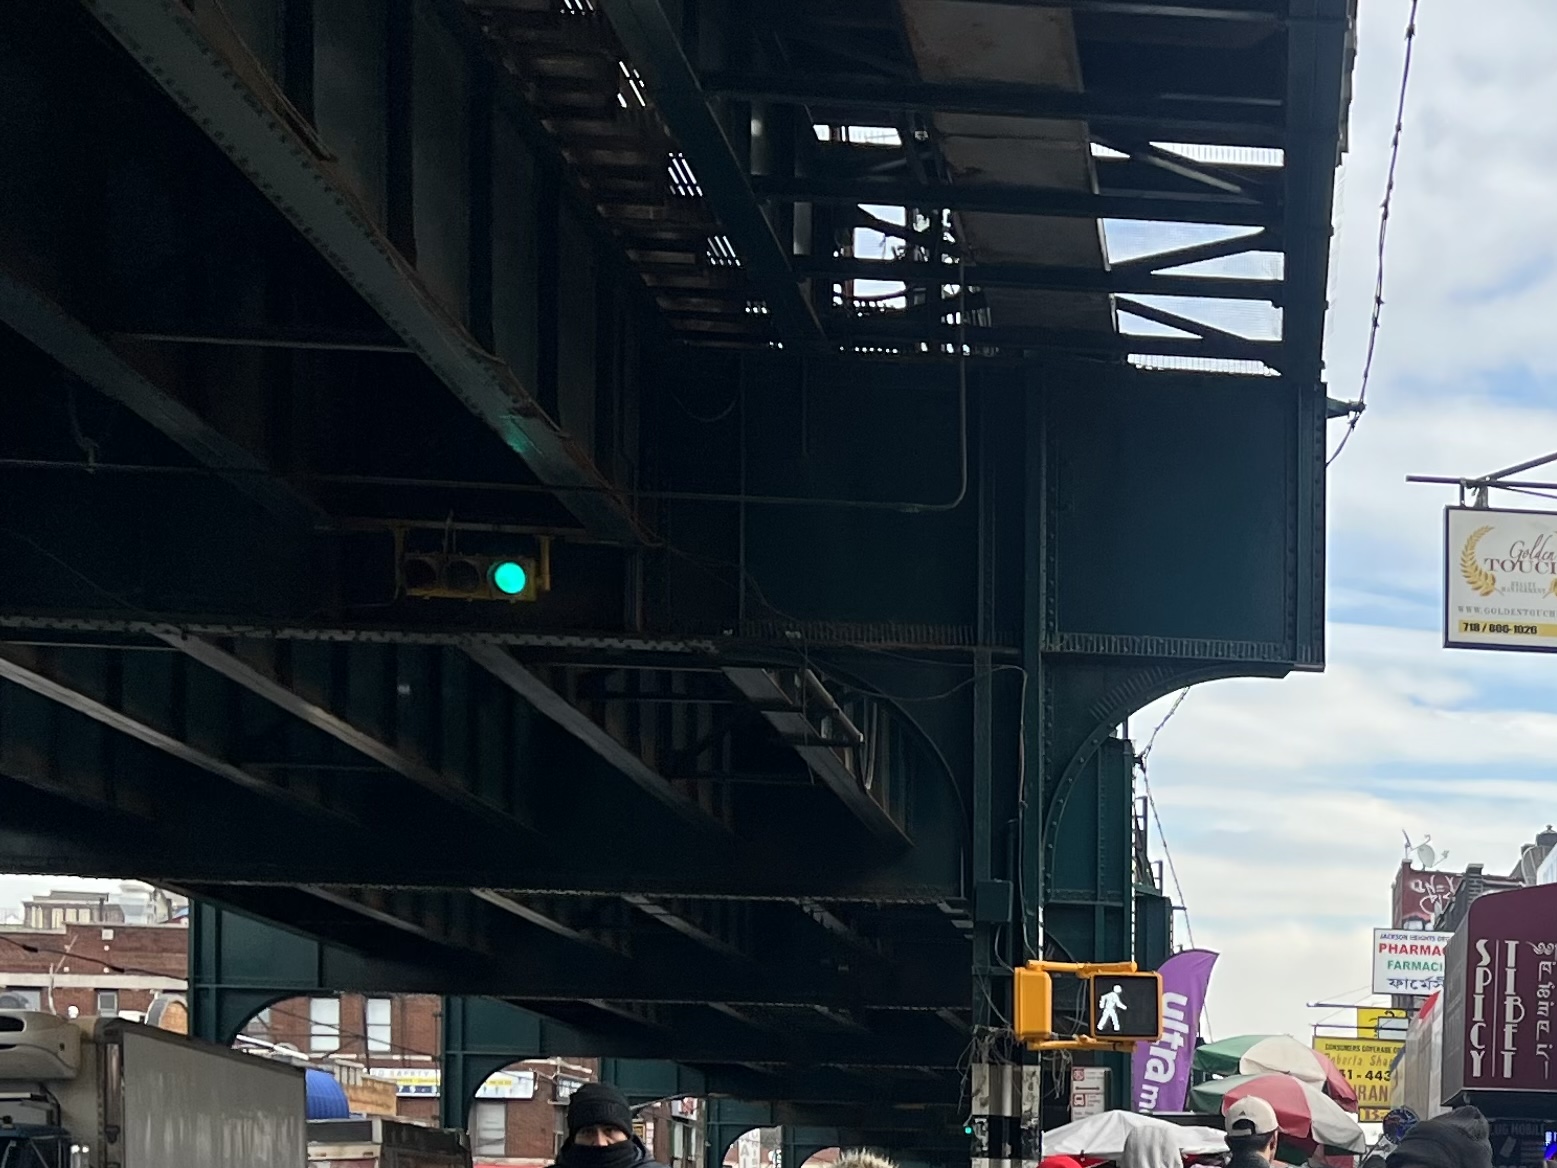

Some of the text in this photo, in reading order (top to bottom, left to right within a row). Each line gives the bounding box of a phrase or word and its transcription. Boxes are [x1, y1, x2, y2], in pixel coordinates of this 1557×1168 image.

[1509, 533, 1555, 566] Golden
[1387, 960, 1443, 972] FARMACI
[1470, 939, 1492, 1077] SPICY
[1500, 940, 1525, 1079] TIBET
